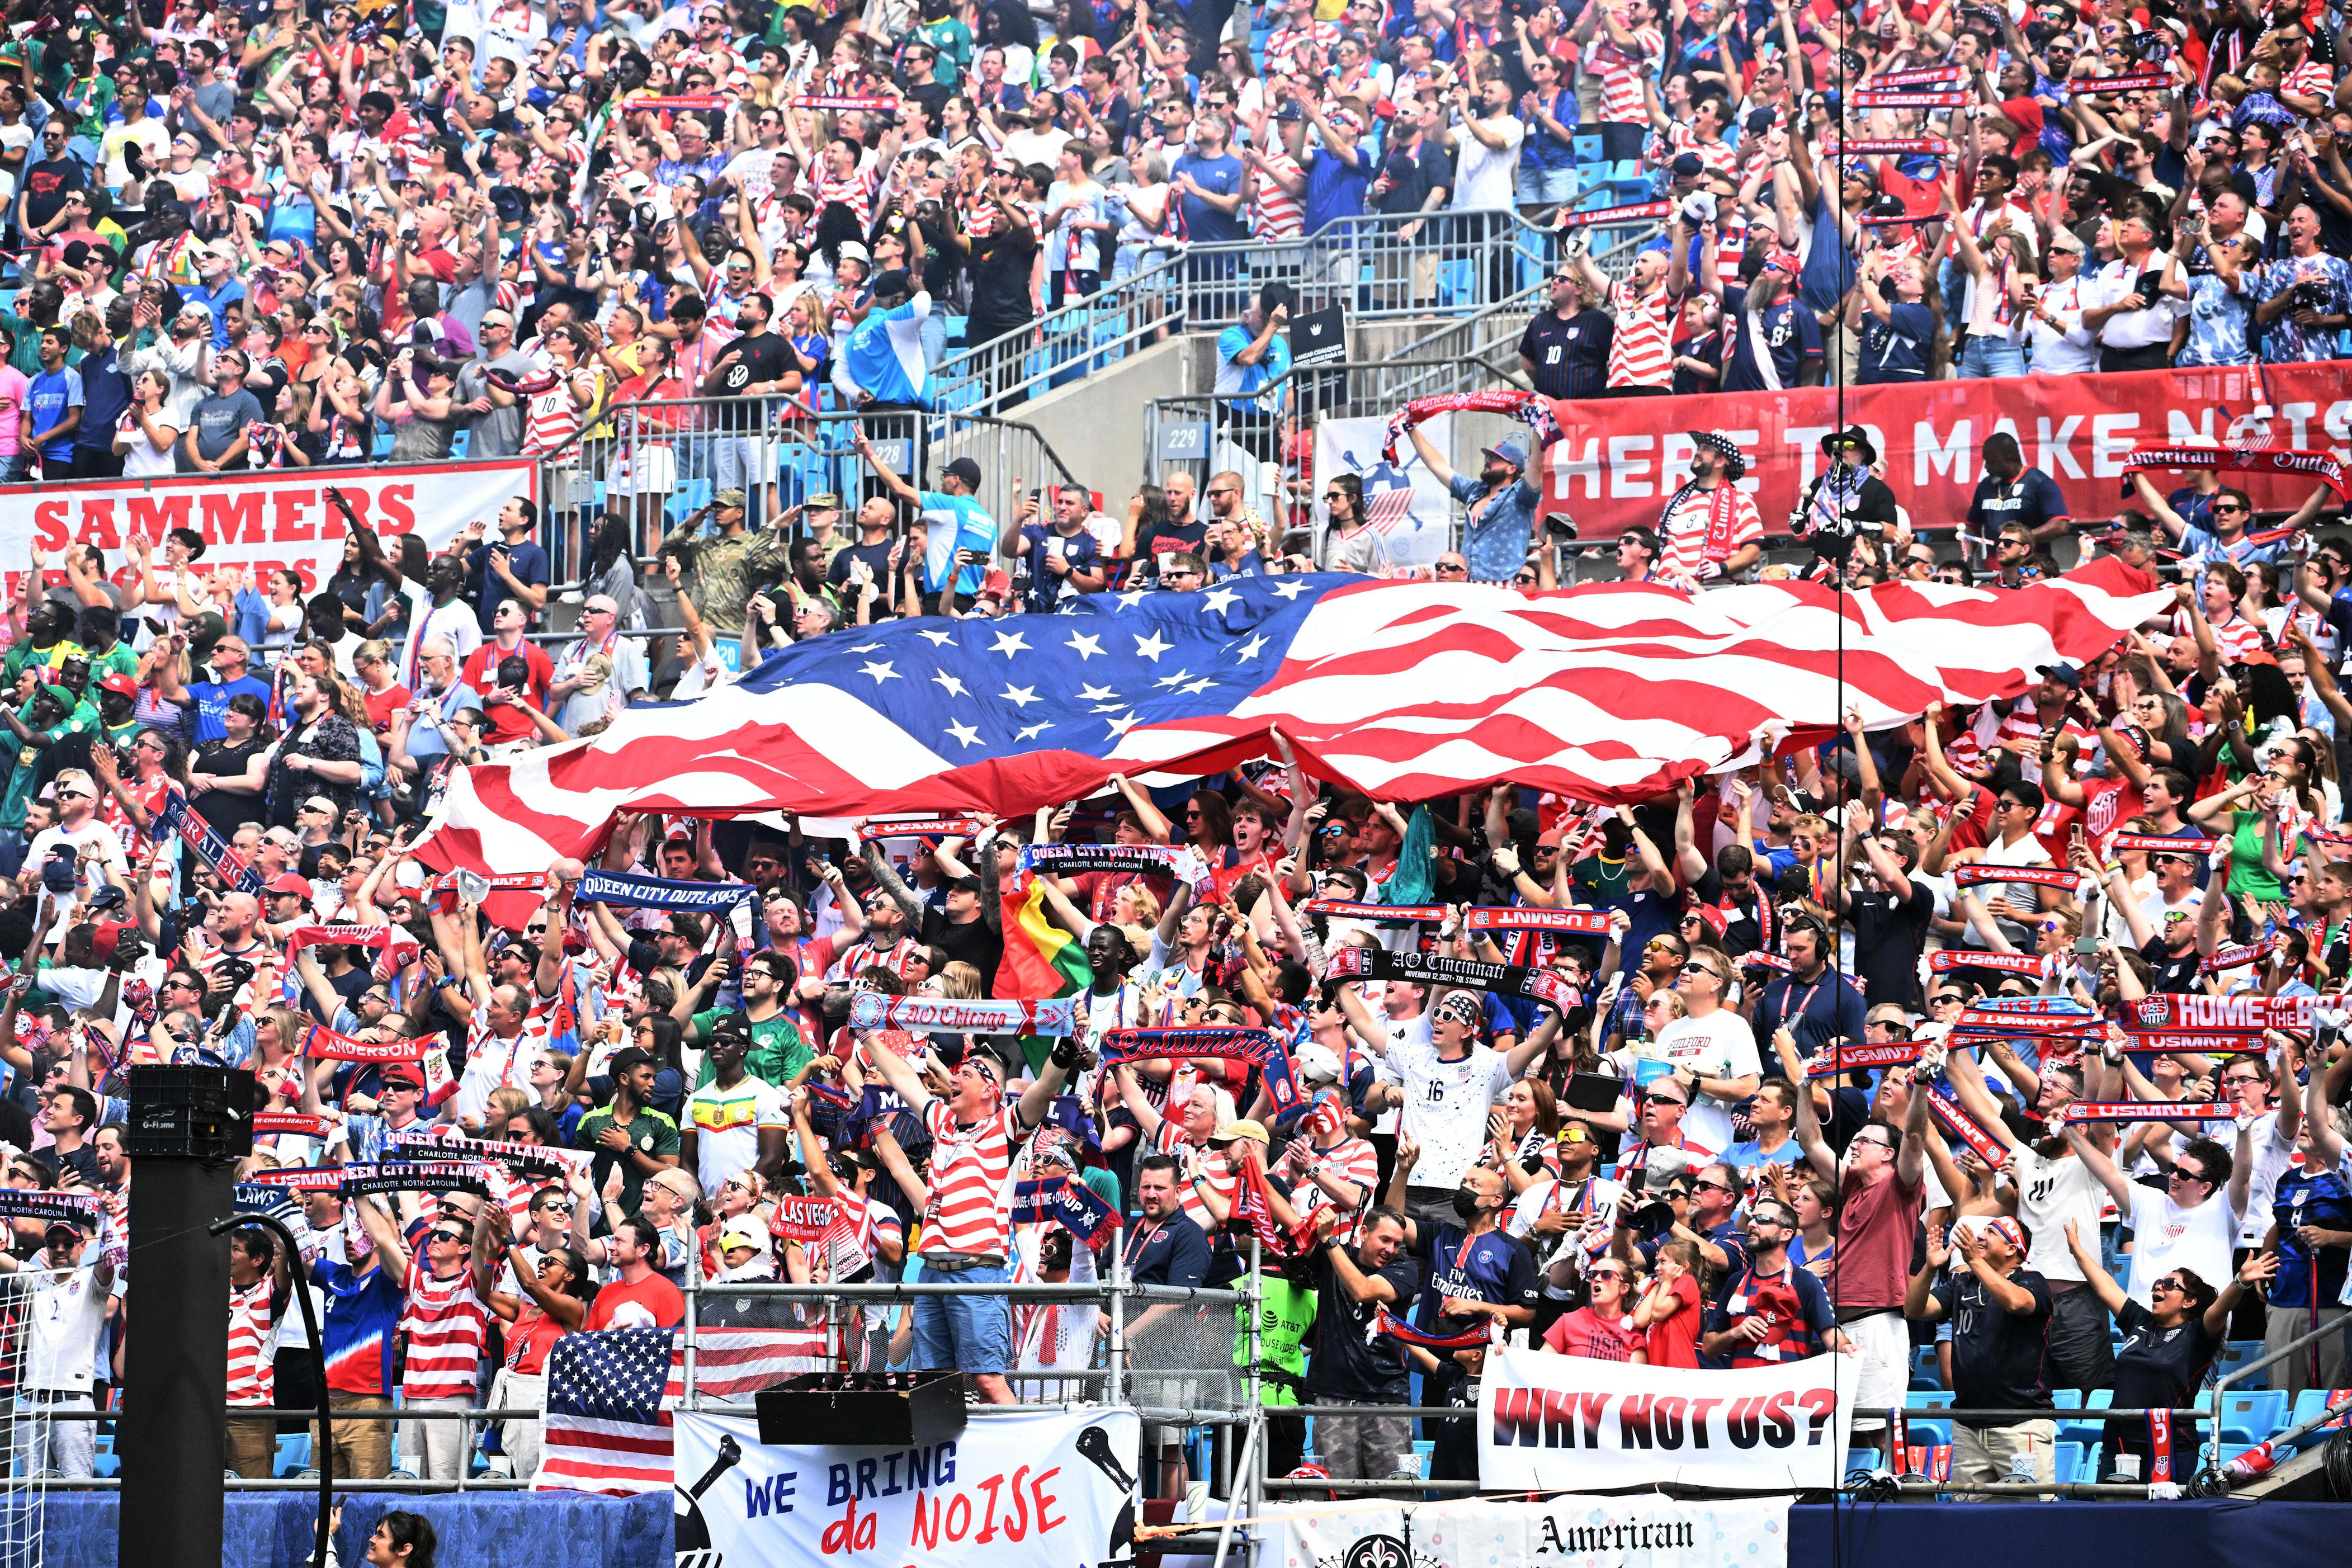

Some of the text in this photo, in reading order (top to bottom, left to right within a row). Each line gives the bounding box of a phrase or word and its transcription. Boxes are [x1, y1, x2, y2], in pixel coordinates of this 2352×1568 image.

[1888, 71, 1943, 86] USMNT
[2090, 78, 2151, 90] USMNT
[813, 98, 876, 108] USMNT
[1876, 94, 1943, 105] USMNT
[1847, 141, 1923, 151] USMNT
[1585, 206, 1649, 222] USMNT
[1772, 326, 1785, 347] 8
[1546, 345, 1562, 365] 10
[542, 396, 557, 414] 10
[1411, 394, 1455, 412] American
[1169, 428, 1197, 449] 229
[876, 445, 900, 465] 228
[2126, 447, 2217, 468] American
[34, 484, 415, 552] SAMMERS
[1686, 513, 1697, 529] 8
[1713, 487, 1729, 540] United
[189, 822, 257, 895] RALEIGH
[1032, 846, 1168, 861] QUEEN CITY OUTLAWS
[1113, 861, 1144, 870] CAROLINA
[584, 877, 740, 905] QUEEN CITY OUTLAWS
[1499, 911, 1582, 927] USMNT
[1956, 953, 2035, 969] USMNT
[2212, 944, 2260, 967] USMNT
[1392, 951, 1508, 980] AO Cincinnati
[1405, 970, 1487, 986] NOVEMBER TQL STADIUM
[1536, 975, 1552, 996] CINCY
[1998, 999, 2049, 1013] USA
[2178, 994, 2296, 1027] HOME OF THE
[939, 1005, 1007, 1032] Chicago
[325, 1038, 417, 1057] ANDERSON
[1106, 1030, 1275, 1069] Columbus
[1668, 1036, 1711, 1050] GUILFORD
[2149, 1036, 2237, 1048] USMNT
[1841, 1046, 1912, 1064] USMNT
[1425, 1079, 1444, 1102] 16
[1926, 1085, 1986, 1145] USMNT
[2098, 1103, 2203, 1116] USMNT
[143, 1121, 175, 1129] G-Flame
[286, 1117, 314, 1126] REALITY
[970, 1128, 983, 1137] USA
[386, 1132, 559, 1162] QUEEN CITY OUTLAWS
[418, 1150, 460, 1160] CHARLOTTE,
[341, 1163, 485, 1181] UEEN CITY OUTLAWS
[362, 1179, 402, 1190] CHARLOTTE,
[426, 1179, 460, 1188] CAROLINA
[1031, 1192, 1052, 1207] OUR TIME
[1309, 1187, 1319, 1210] 8
[34, 1207, 68, 1217] CAROLINA
[781, 1200, 804, 1225] LAS
[2293, 1207, 2302, 1225] 8
[847, 1255, 862, 1269] VEGAS
[1449, 1268, 1466, 1284] Fly
[1432, 1272, 1483, 1303] Emirates
[324, 1292, 335, 1312] 4
[1281, 1323, 1301, 1333] AT&T
[1958, 1309, 1973, 1335] 10
[1591, 1335, 1622, 1348] USA
[2165, 1329, 2181, 1338] USA
[1260, 1338, 1278, 1349] OUSE
[1494, 1387, 1839, 1451] WHY NOT US?
[2156, 1457, 2169, 1466] USA
[745, 1440, 957, 1519] WE BRING
[821, 1464, 1068, 1555] da NOISE
[1537, 1515, 1694, 1554] American
